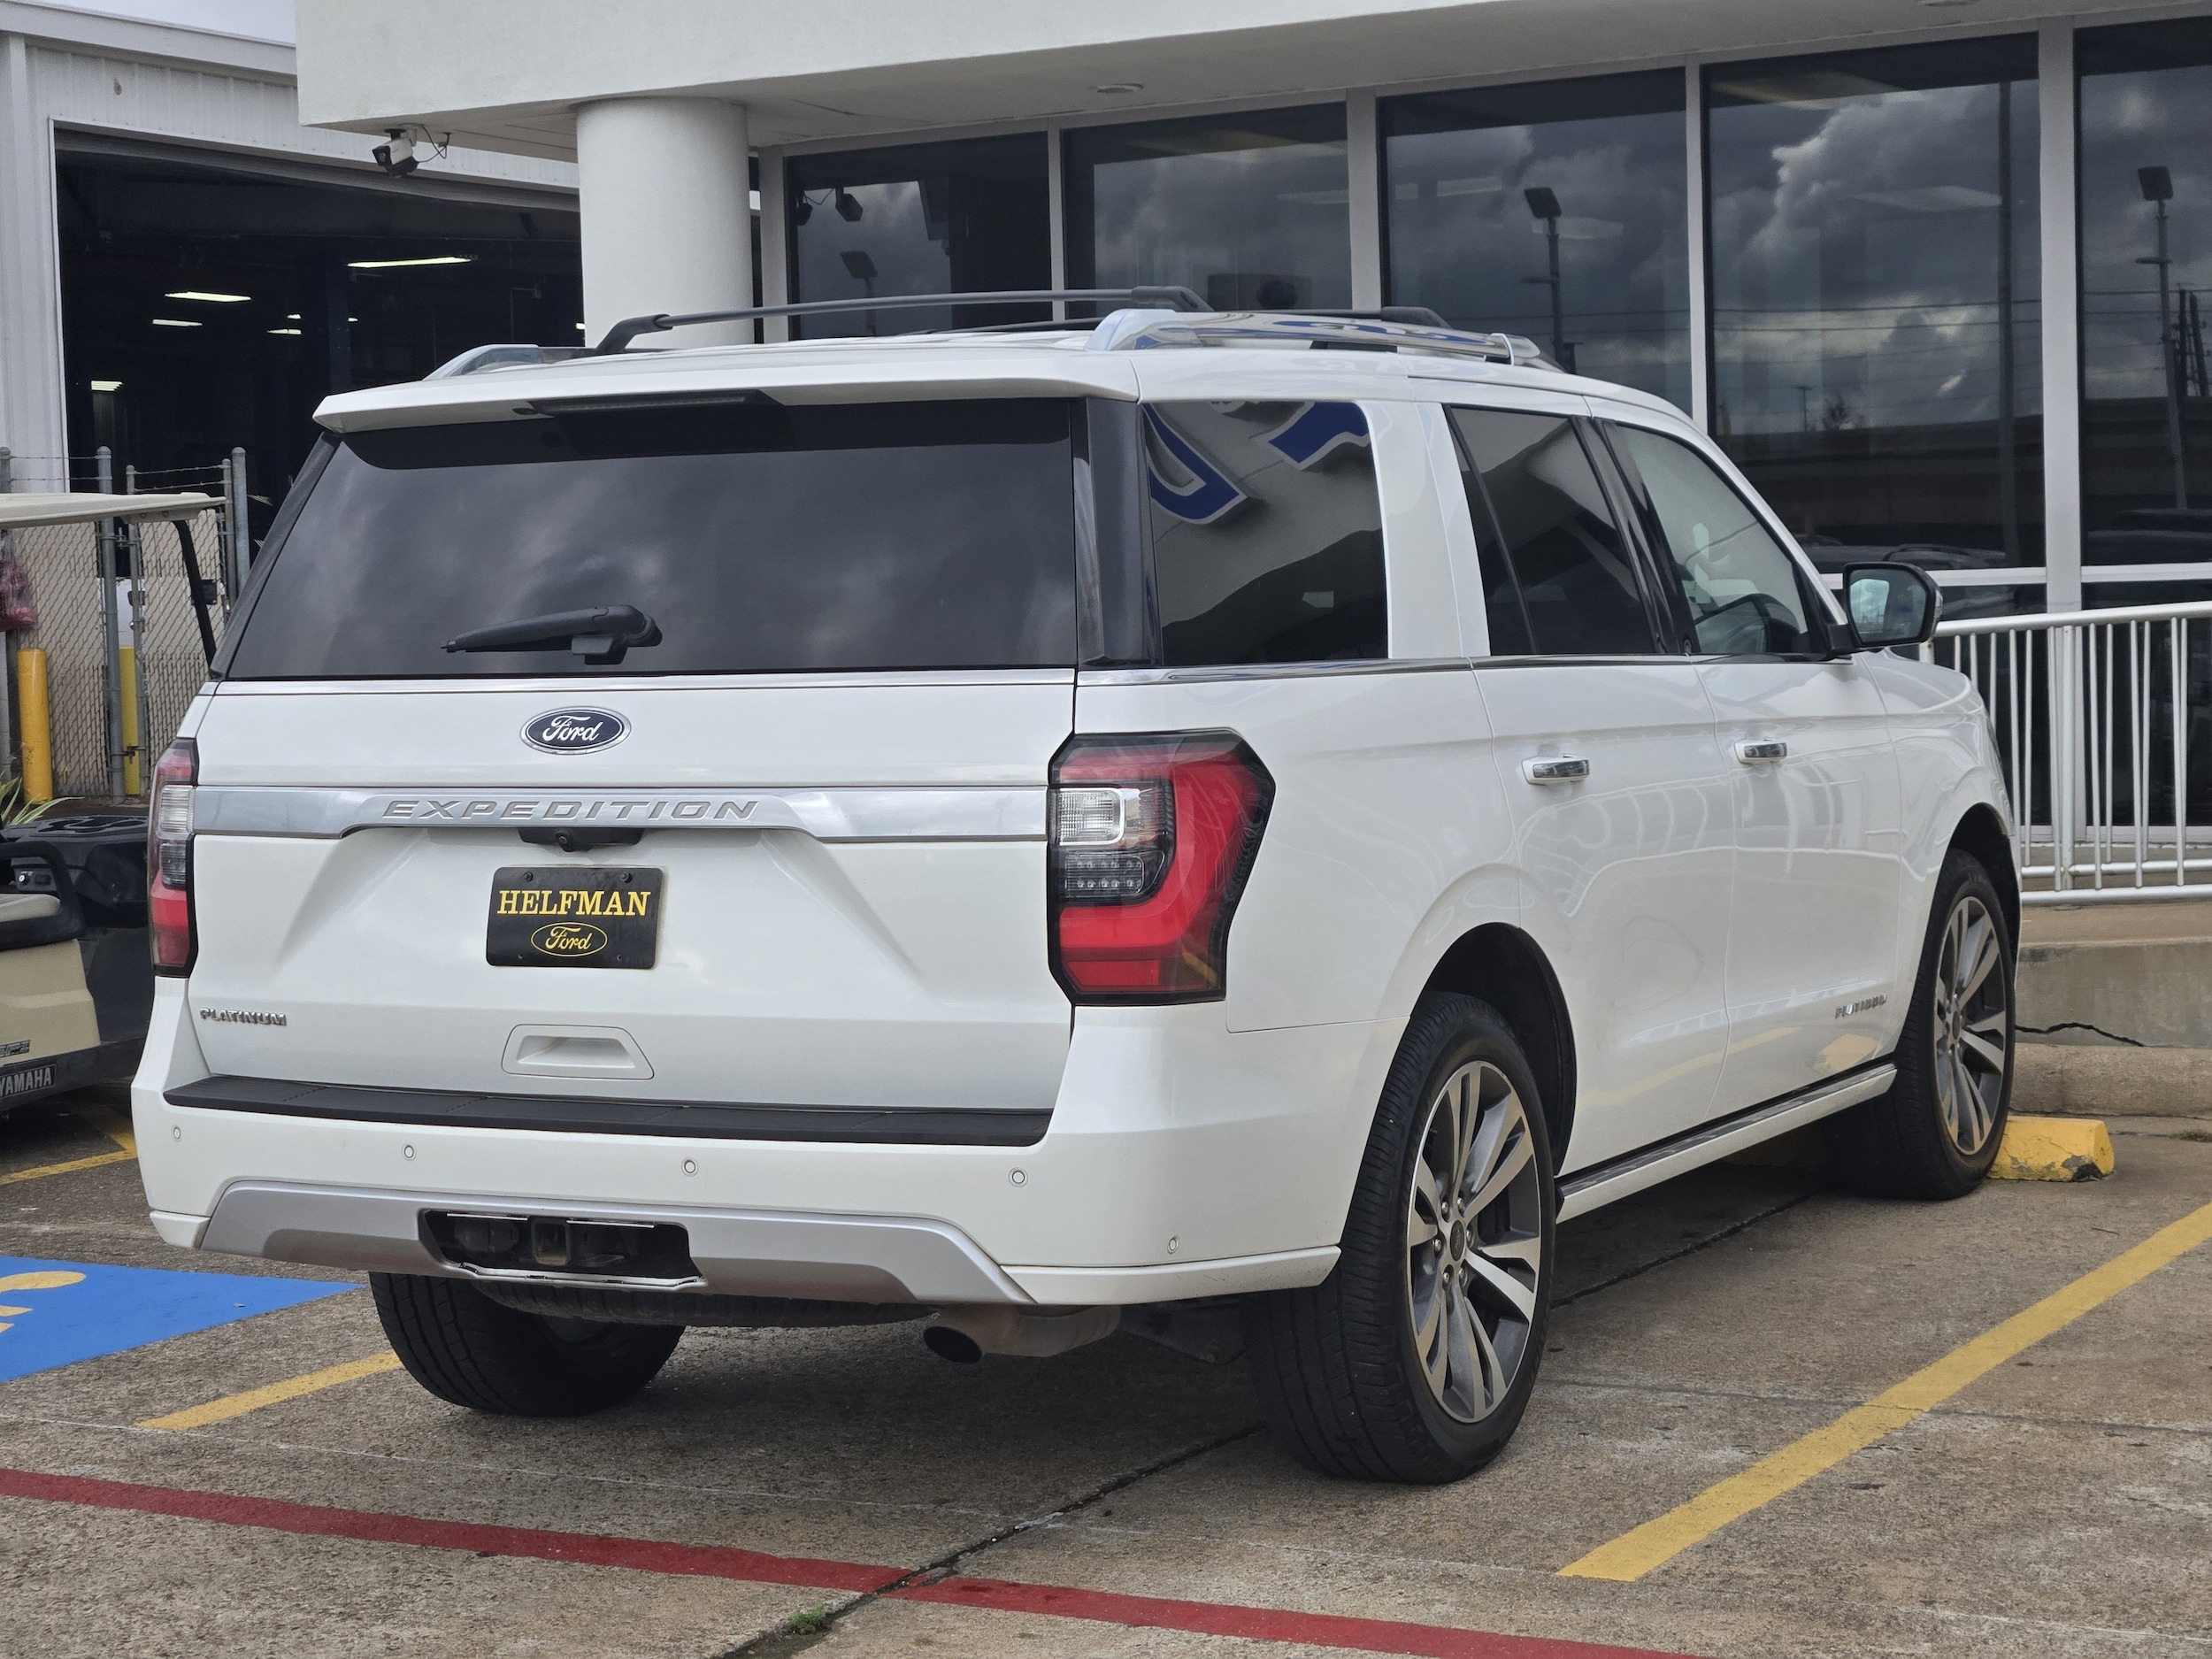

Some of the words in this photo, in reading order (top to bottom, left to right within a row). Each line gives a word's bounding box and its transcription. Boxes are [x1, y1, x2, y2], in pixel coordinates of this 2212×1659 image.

[542, 715, 601, 742] Ford
[381, 800, 759, 820] EXPEDITION
[496, 889, 651, 917] HELFMAN
[545, 926, 593, 950] Ford
[199, 1007, 287, 1026] PLATINUM
[0, 1067, 52, 1097] YAMAHA
